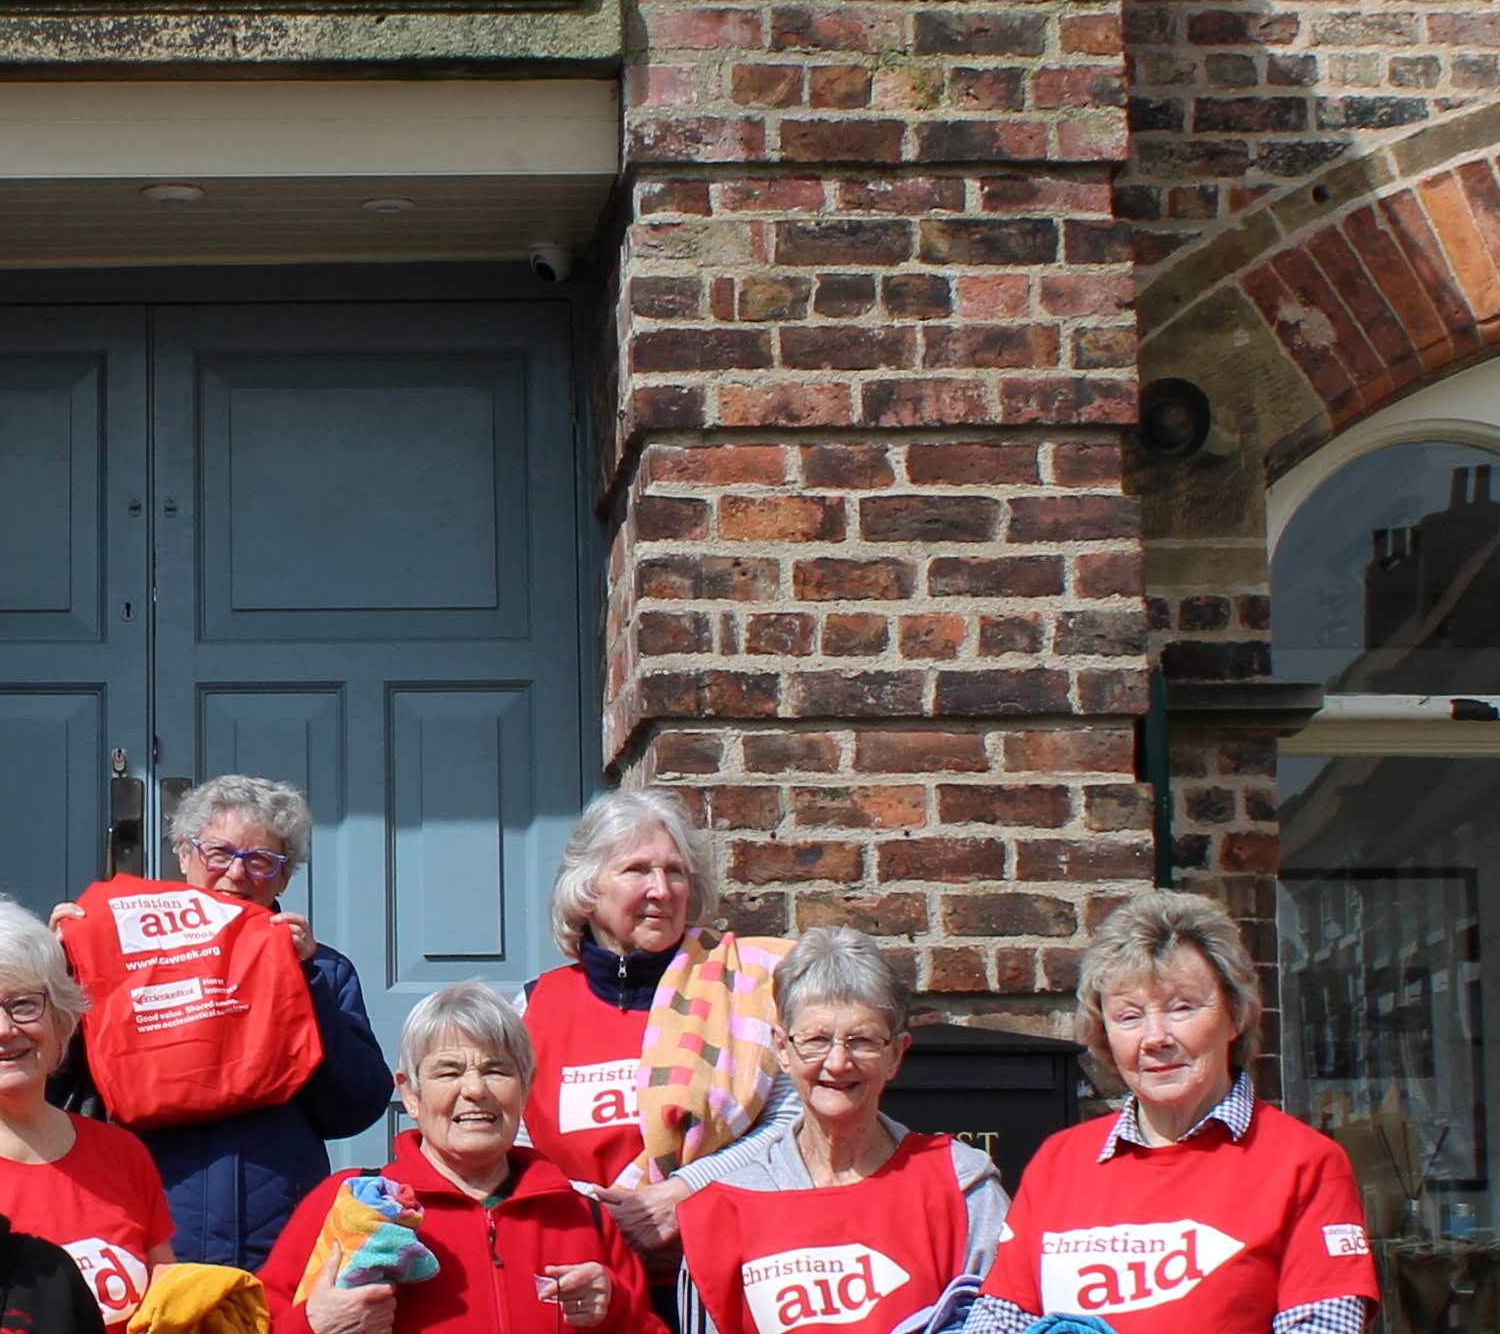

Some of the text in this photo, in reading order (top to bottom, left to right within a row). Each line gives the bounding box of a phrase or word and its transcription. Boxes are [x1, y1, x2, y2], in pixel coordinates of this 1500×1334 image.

[140, 897, 212, 938] aid
[562, 1064, 638, 1084] christi
[1041, 1230, 1166, 1257] christian
[742, 1252, 845, 1286] christian
[1077, 1229, 1203, 1311] aid
[776, 1254, 882, 1327] aid
